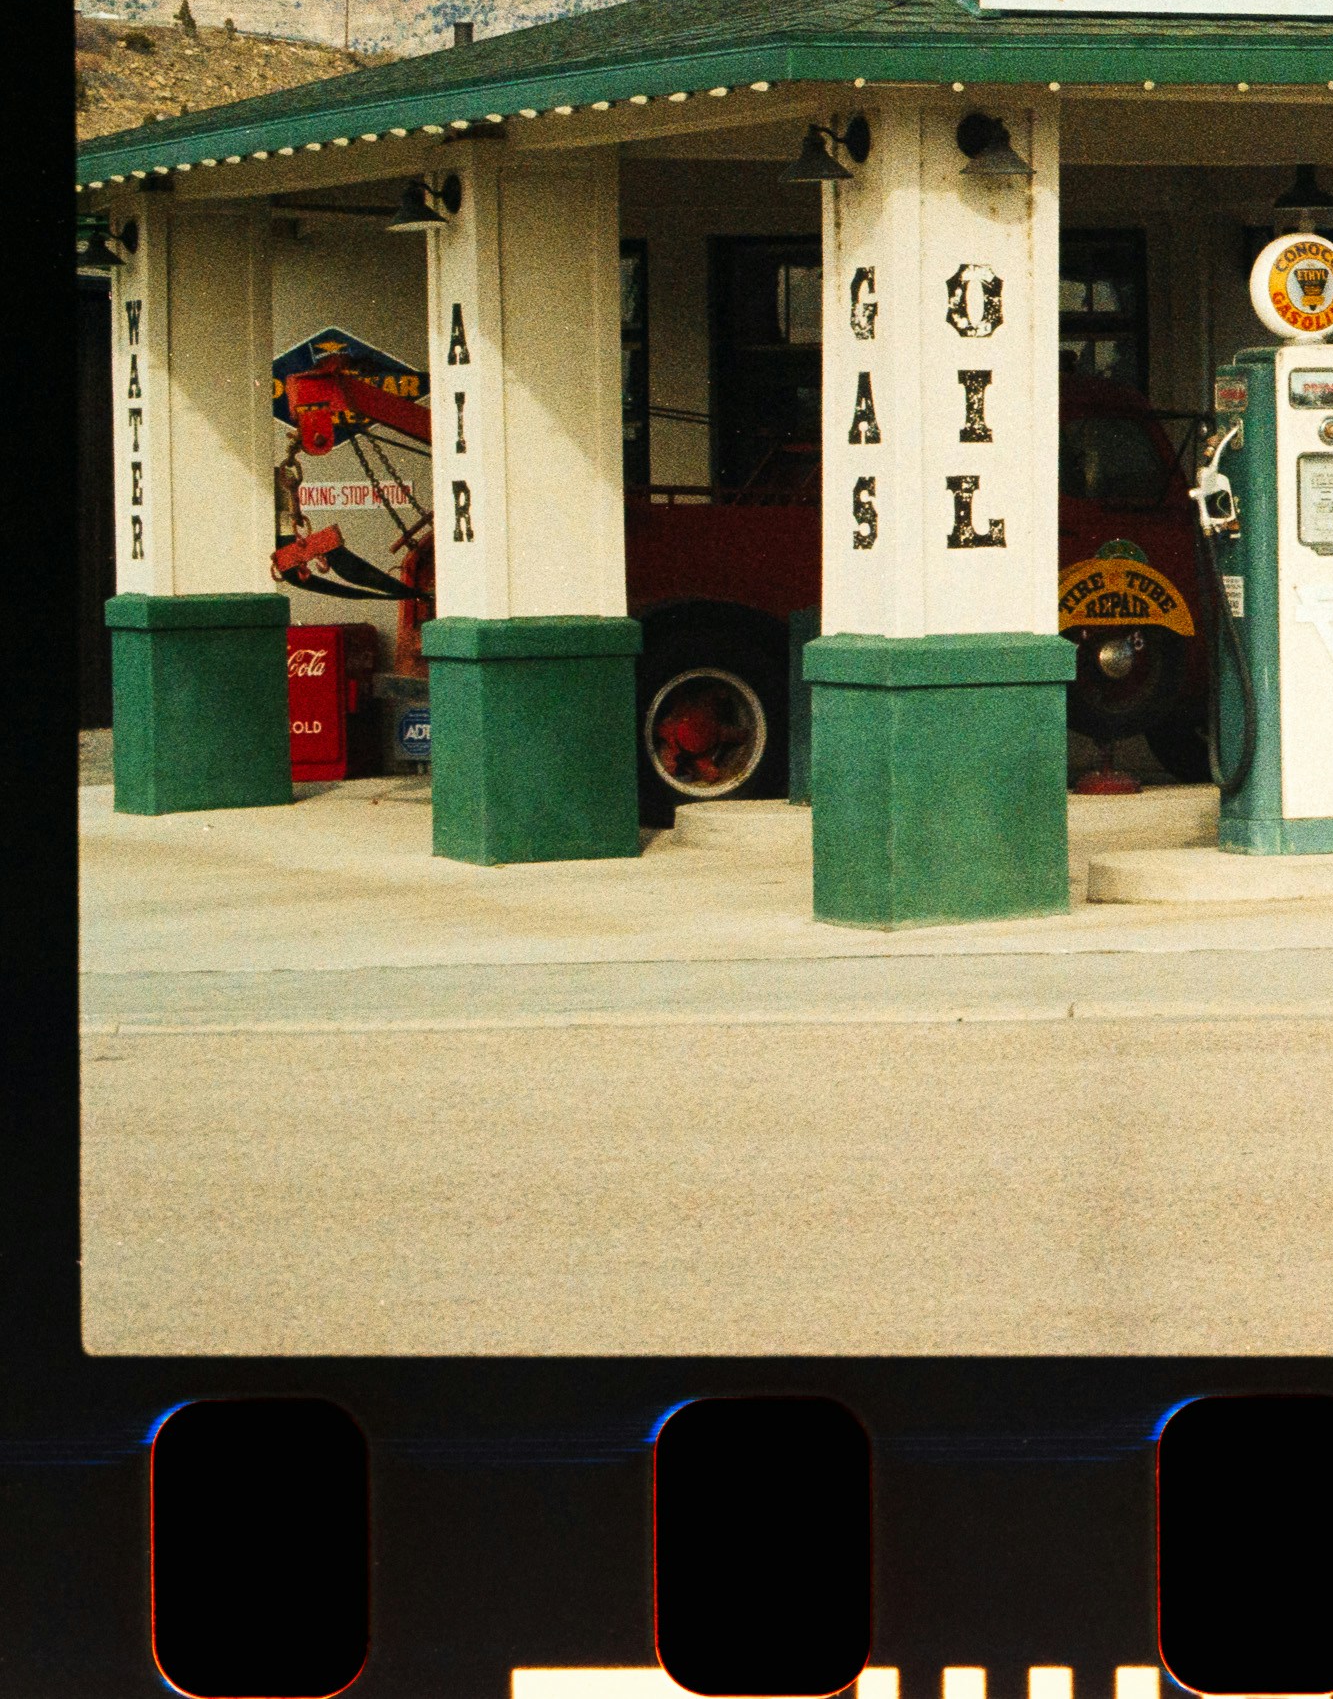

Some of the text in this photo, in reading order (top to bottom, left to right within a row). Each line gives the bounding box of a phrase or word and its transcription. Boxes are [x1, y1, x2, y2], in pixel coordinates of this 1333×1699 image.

[1296, 269, 1328, 282] ETHYL
[125, 300, 145, 560] WATER
[447, 304, 474, 543] AIR
[848, 265, 882, 551] GAS
[945, 263, 1007, 549] OIL
[1058, 571, 1106, 614] TIRE
[1124, 569, 1178, 614] TUBE
[1085, 591, 1150, 618] REPAIR
[289, 721, 322, 734] OLD
